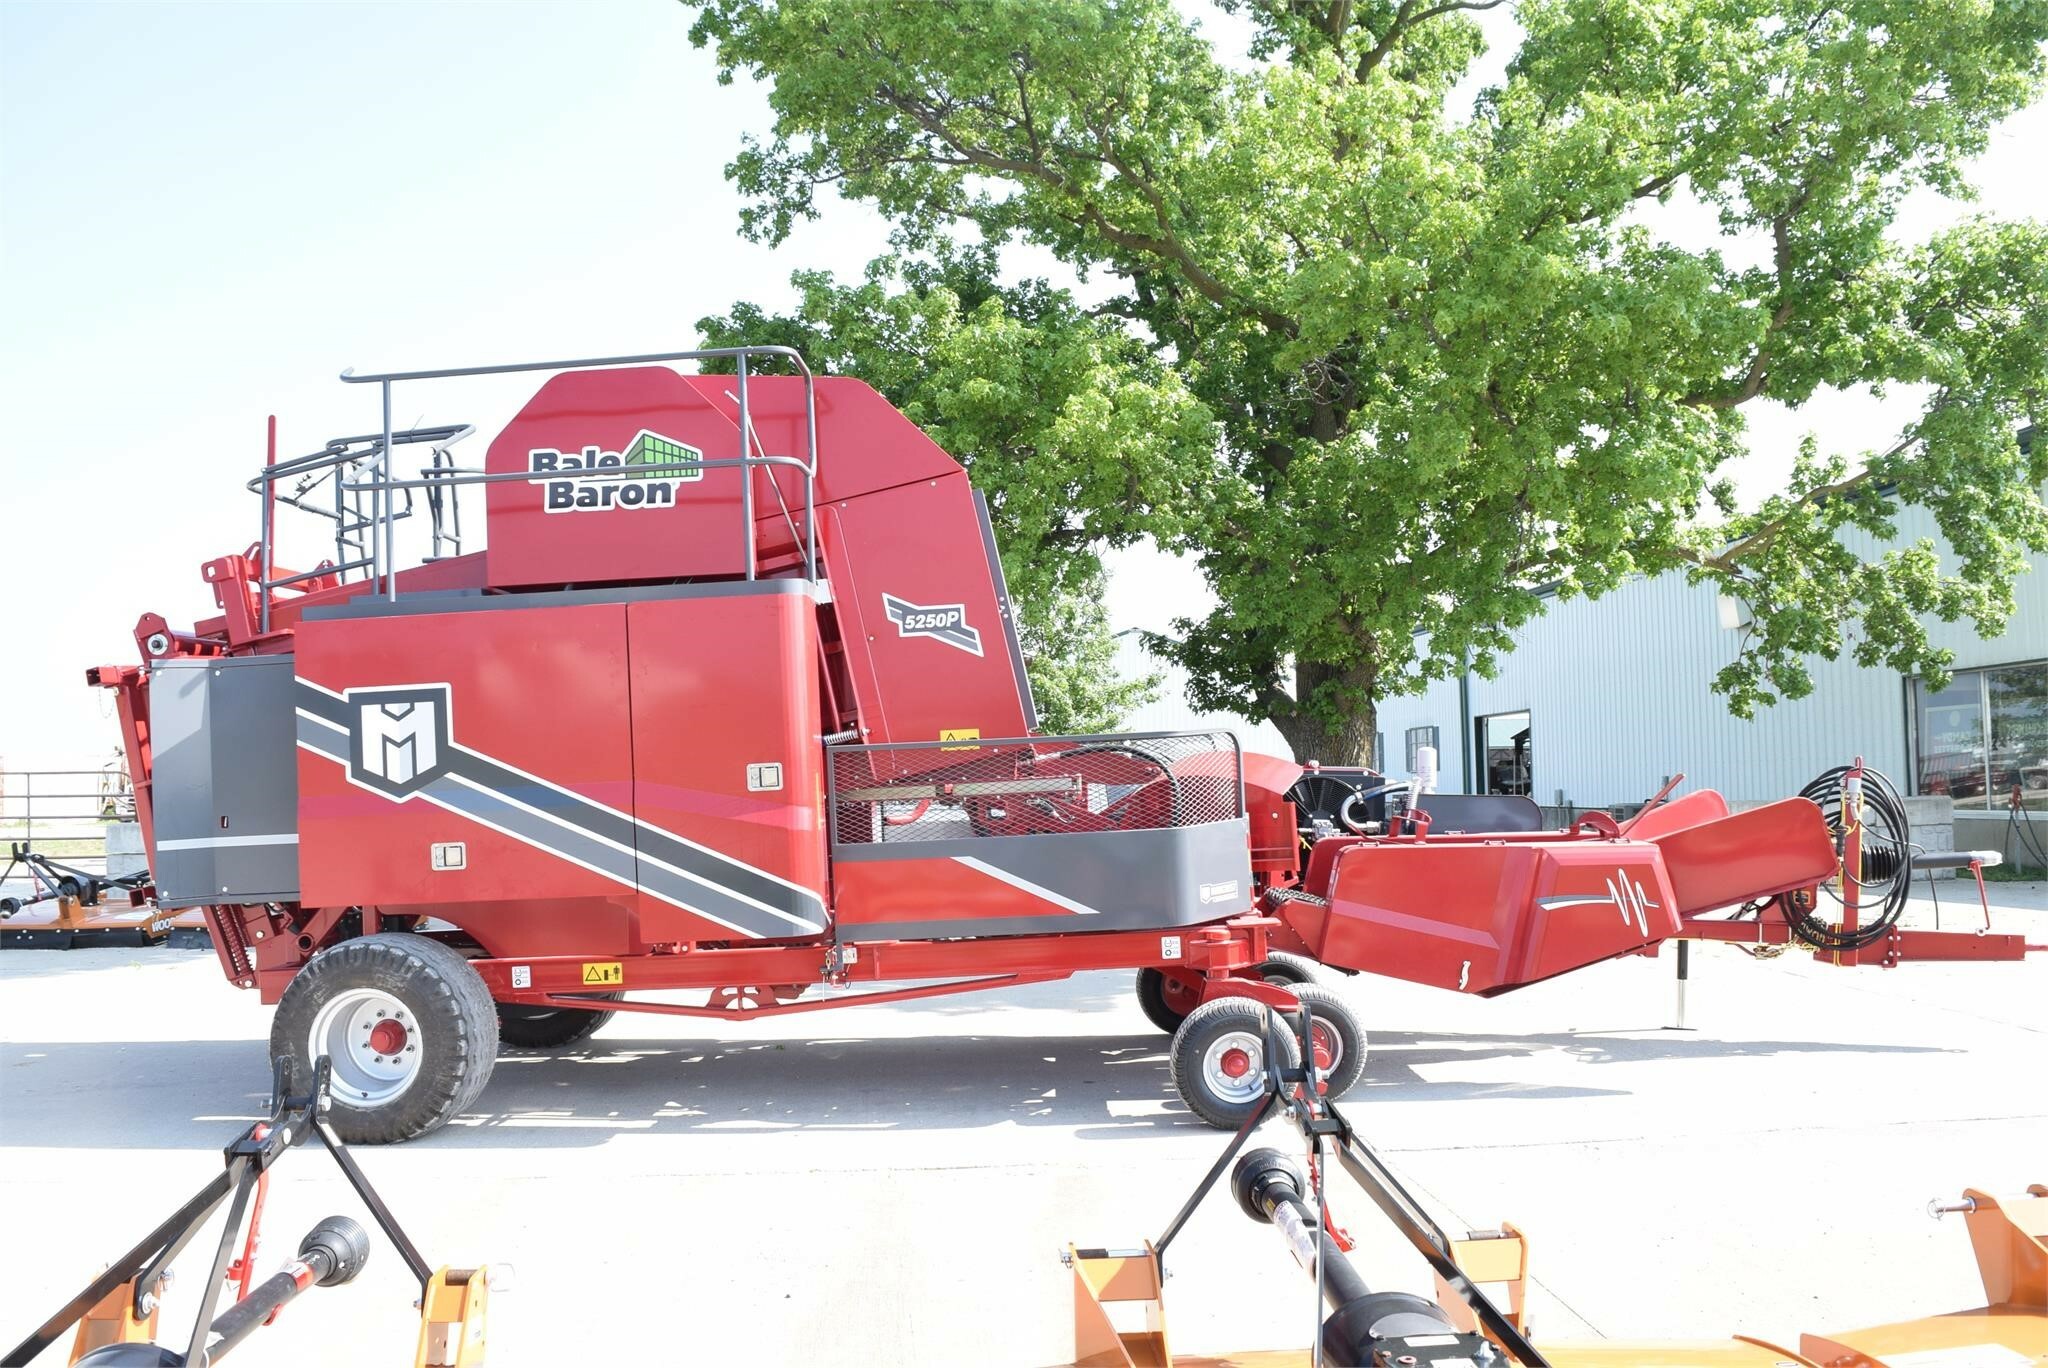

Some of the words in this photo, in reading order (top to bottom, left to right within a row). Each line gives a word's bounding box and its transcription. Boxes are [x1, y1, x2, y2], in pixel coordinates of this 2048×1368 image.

[532, 450, 621, 477] Bale
[548, 481, 672, 509] Baron
[904, 611, 960, 629] 5250P
